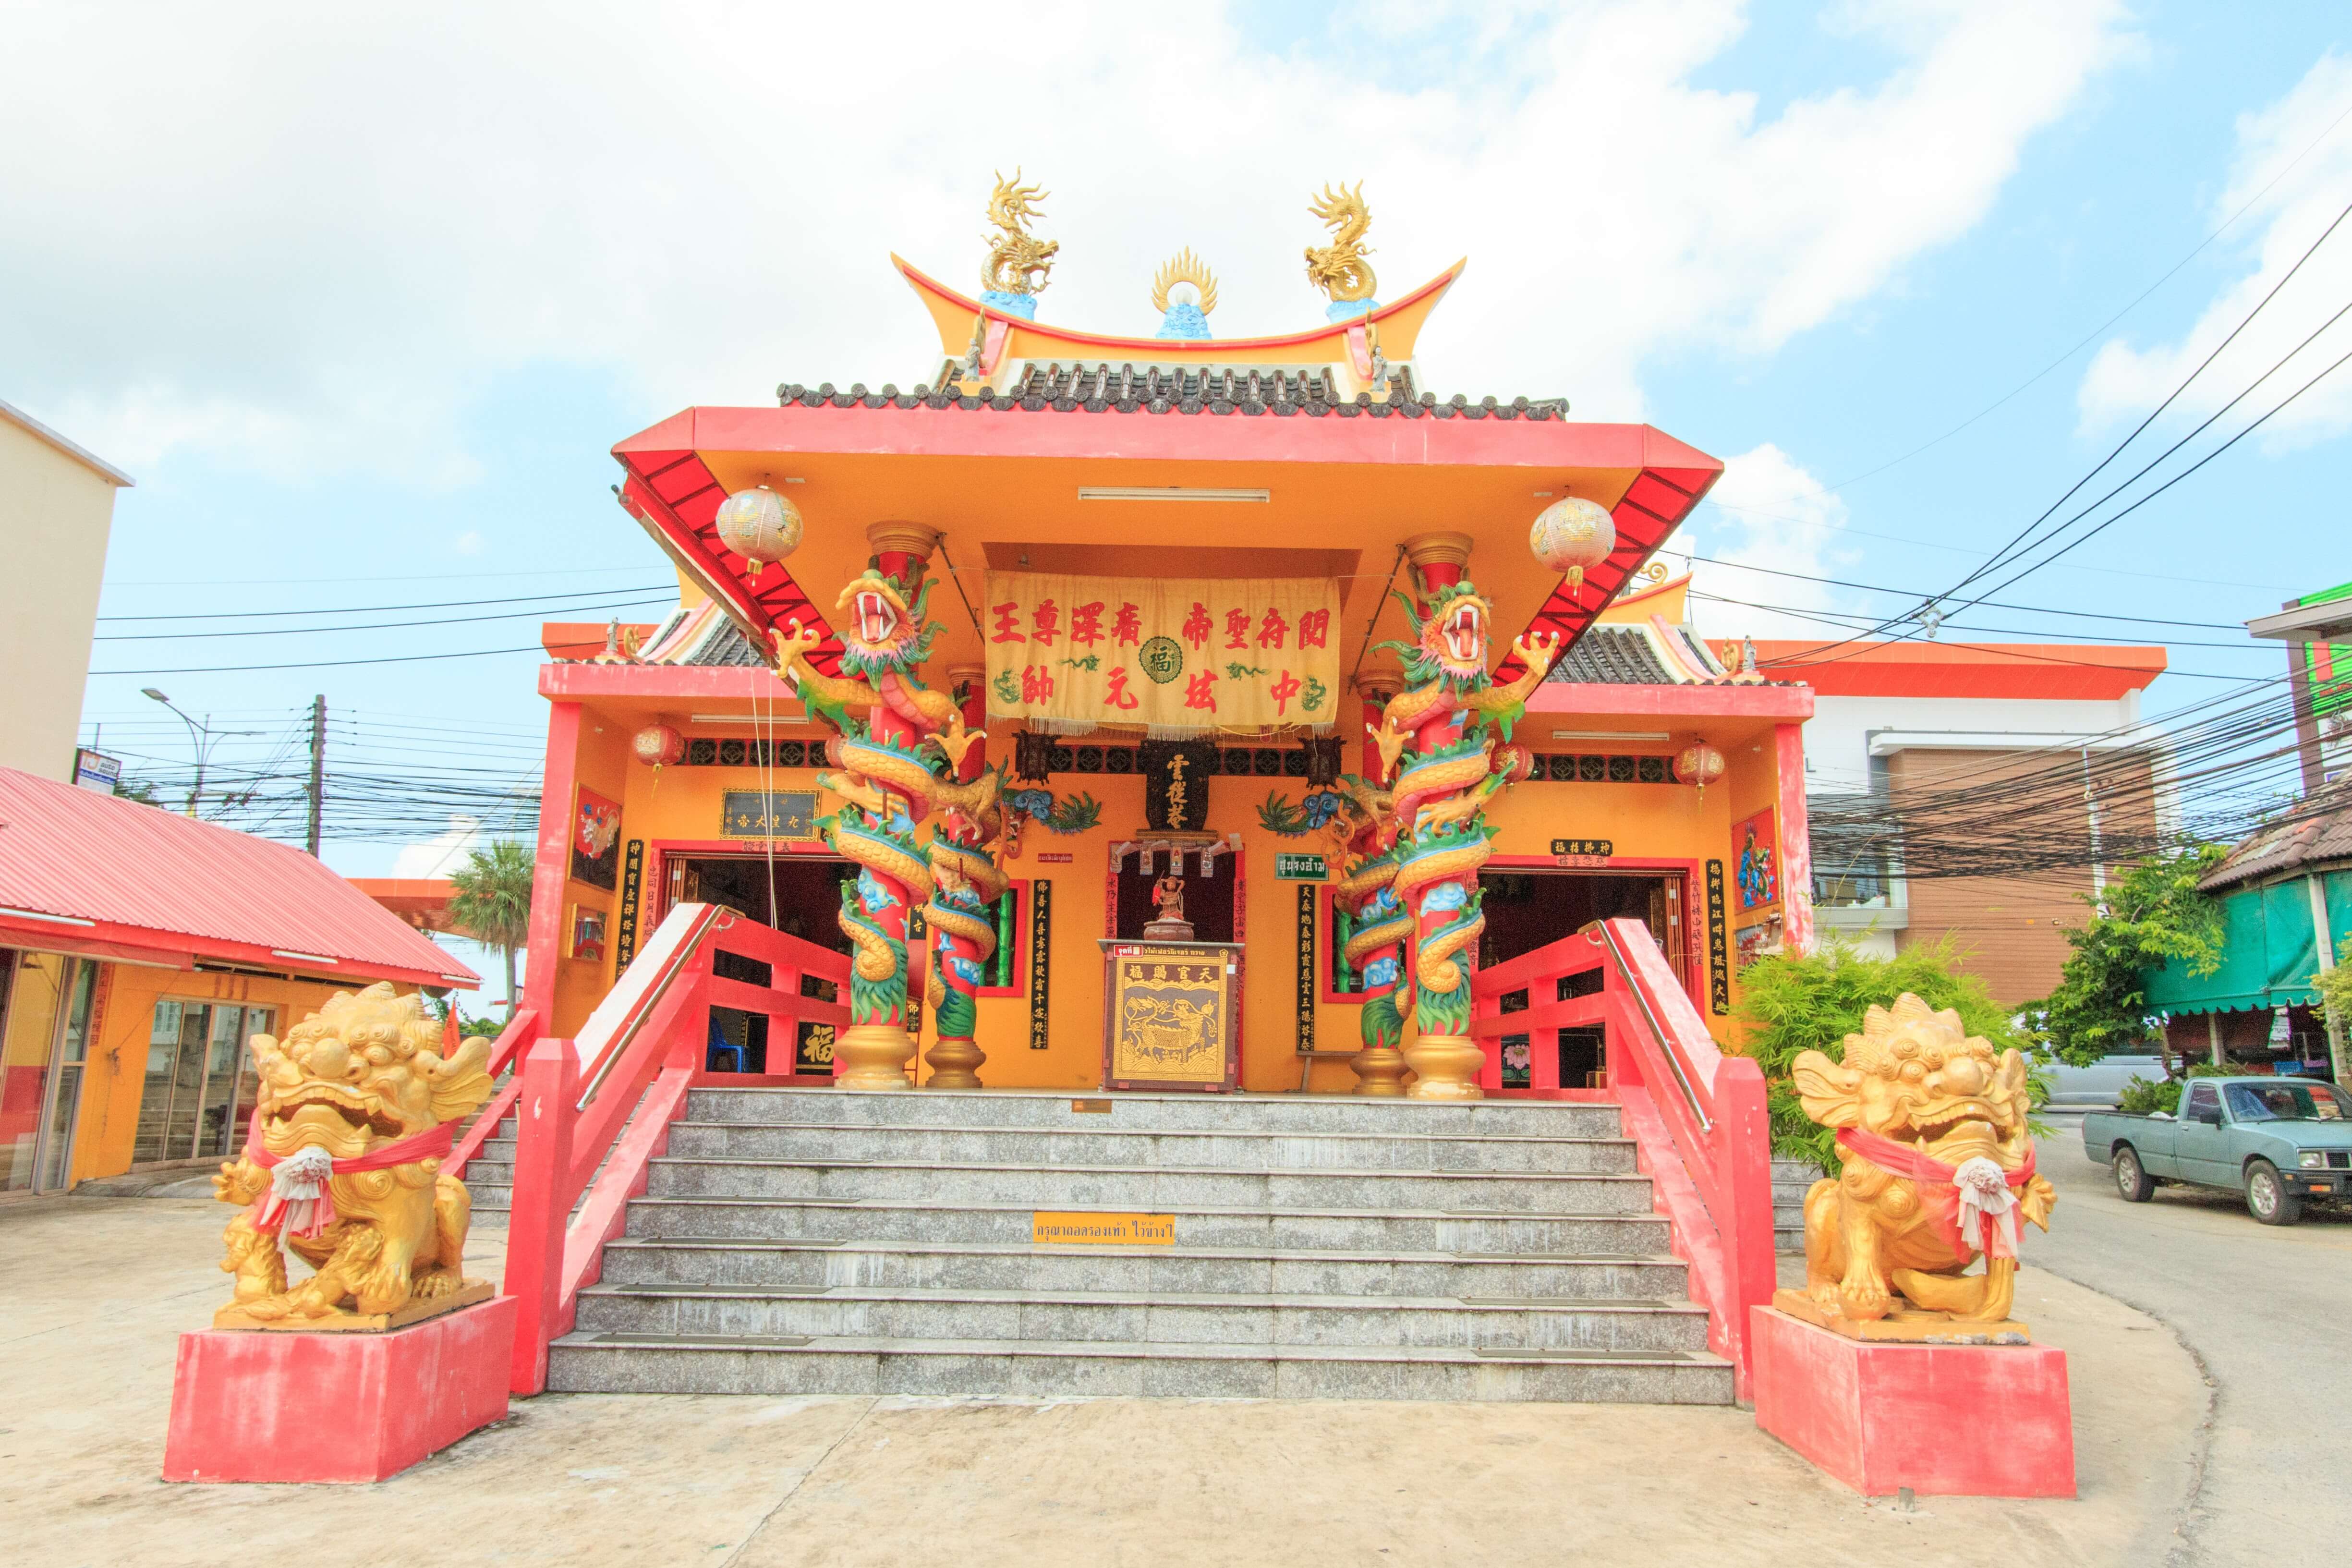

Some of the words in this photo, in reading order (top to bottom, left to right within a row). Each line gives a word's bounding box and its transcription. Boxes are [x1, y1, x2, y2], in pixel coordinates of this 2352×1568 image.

[1150, 645, 1175, 673] 福
[1129, 964, 1213, 980] 天官賜福
[803, 1024, 835, 1063] 福
[1037, 1221, 1126, 1241] กรุณาถอดรองเท้า
